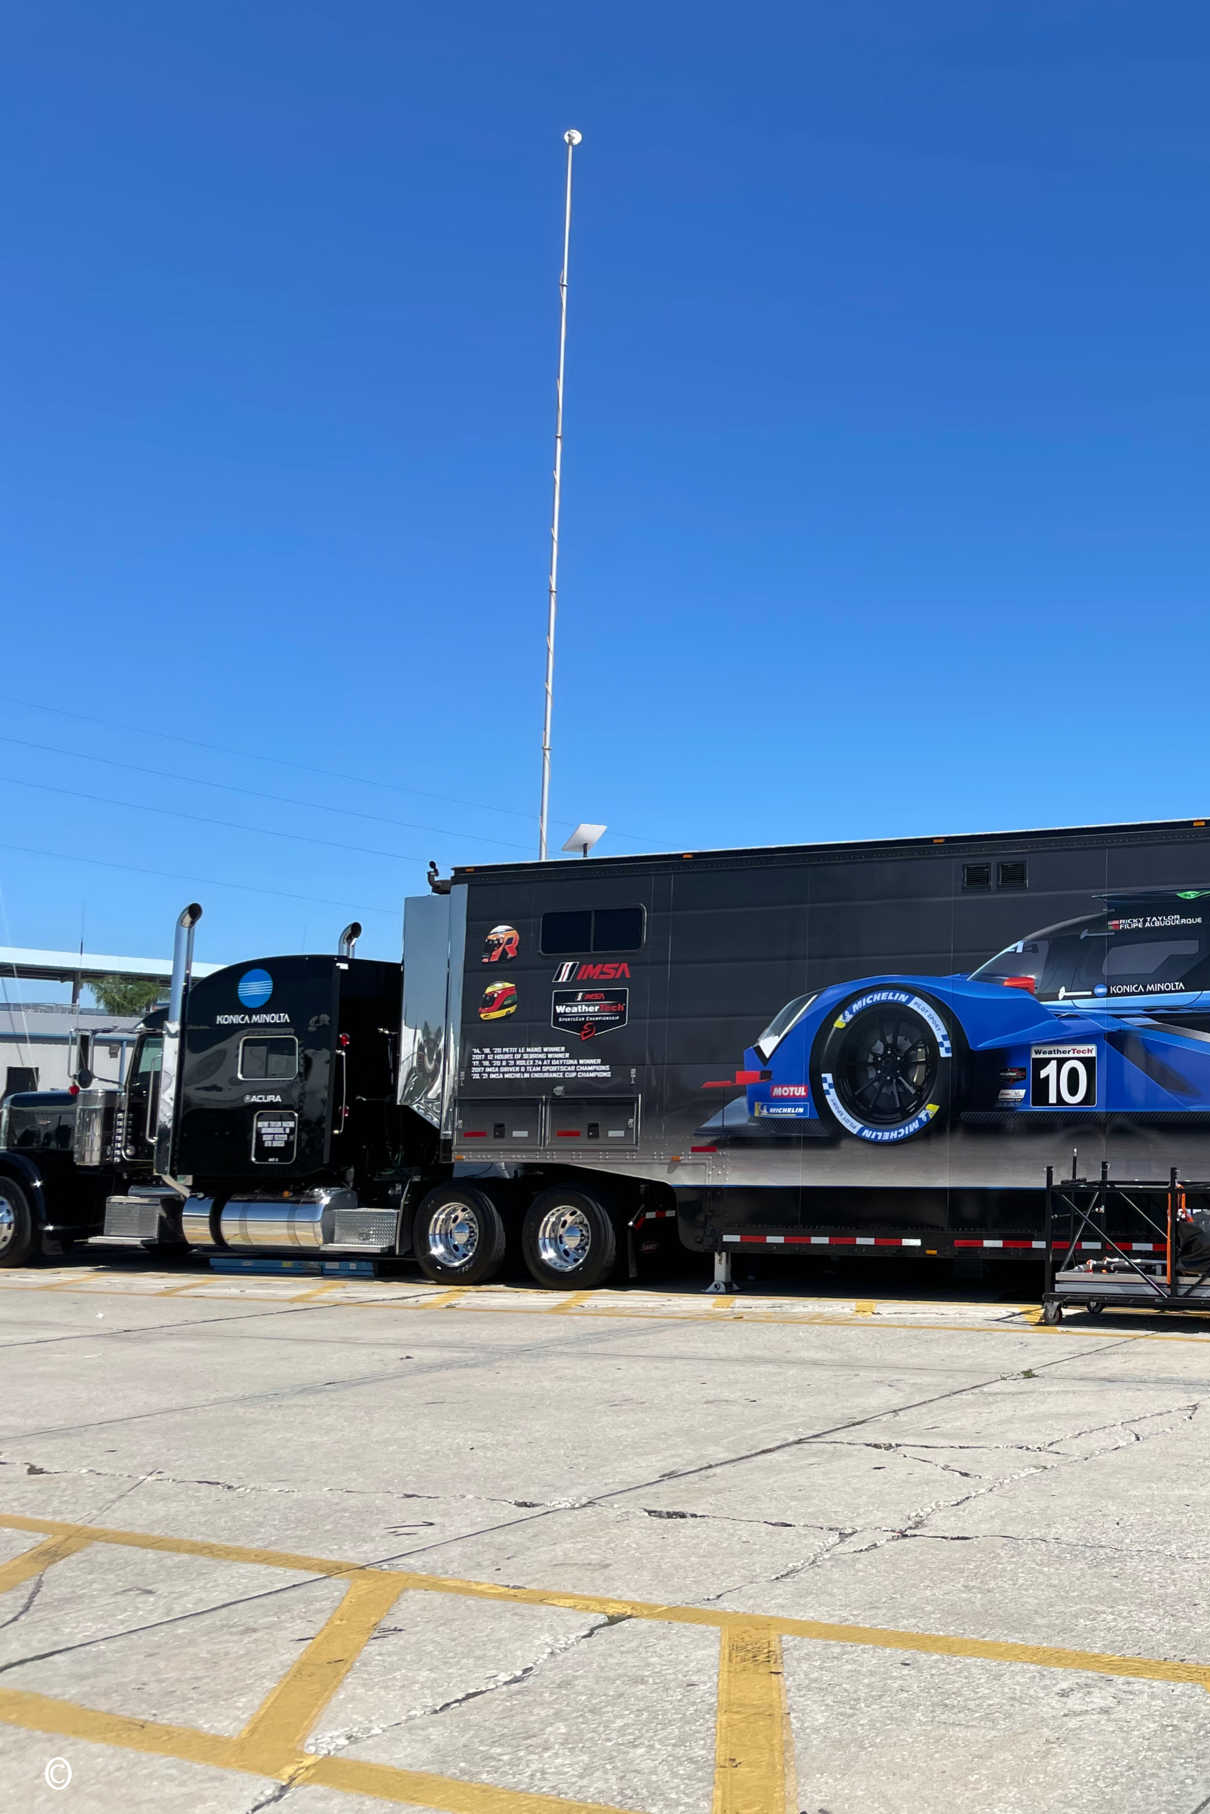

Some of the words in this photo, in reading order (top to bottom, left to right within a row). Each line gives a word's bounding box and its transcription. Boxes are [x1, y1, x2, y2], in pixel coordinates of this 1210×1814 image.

[1120, 921, 1143, 930] FILIPE
[1145, 917, 1202, 927] ALBUQUERQUE
[576, 962, 631, 980] IMSA
[1110, 984, 1145, 994] KONICA
[1146, 982, 1185, 992] MINOLTA
[852, 992, 909, 1012] MICHELIN
[555, 1004, 625, 1013] WeatherTech
[216, 1014, 249, 1024] KONICA
[251, 1013, 290, 1023] MINOLTA
[1033, 1047, 1093, 1055] WeatherTech
[1039, 1059, 1088, 1104] 10
[772, 1086, 807, 1097] MOTUL
[862, 1120, 920, 1140] MICHELIN
